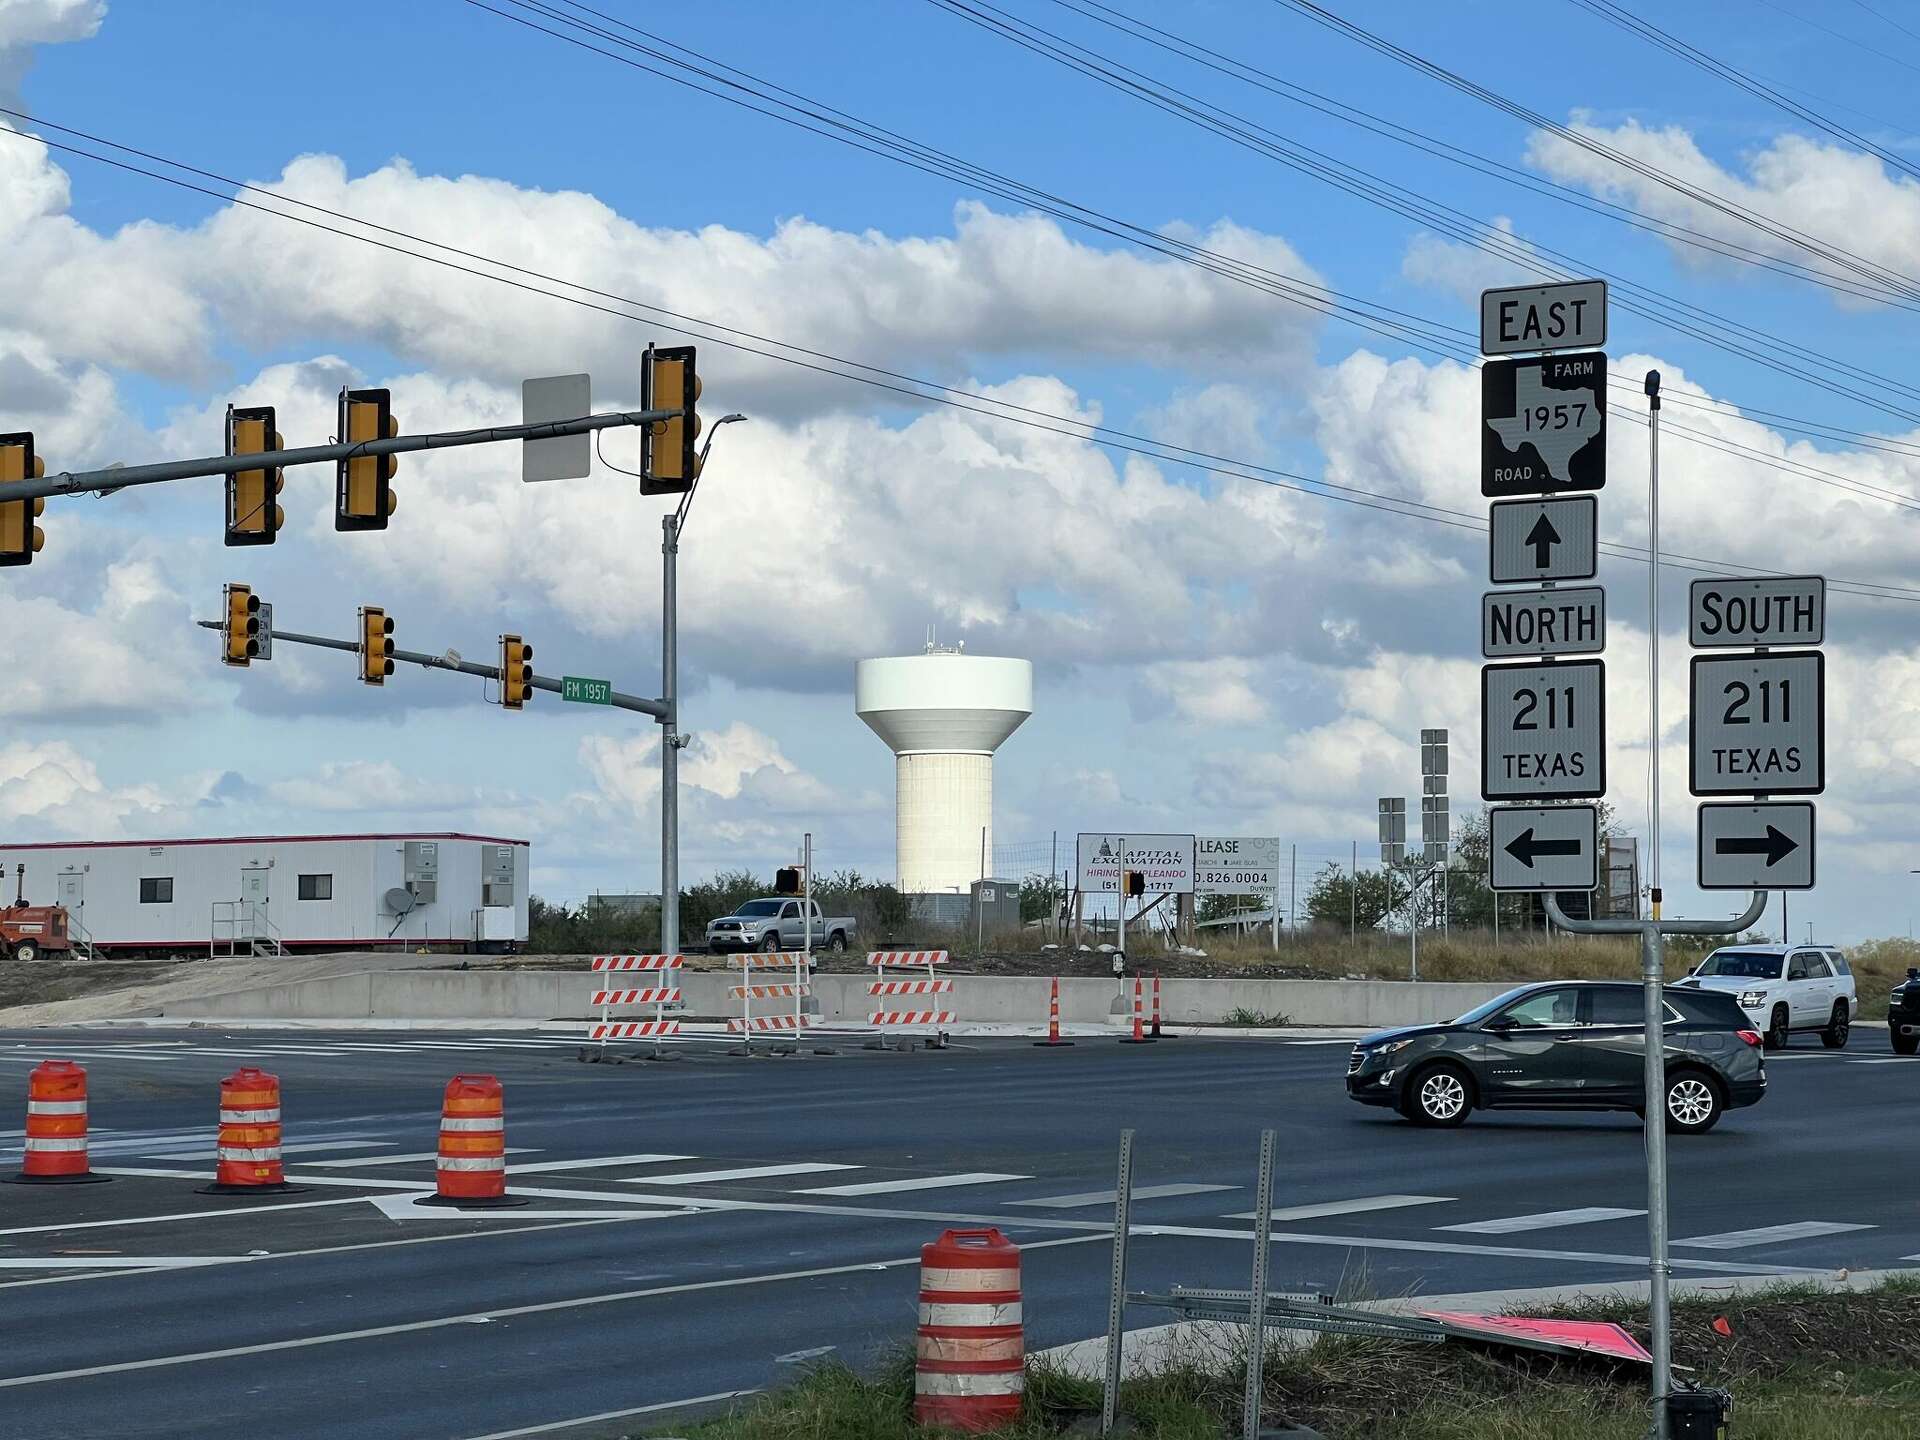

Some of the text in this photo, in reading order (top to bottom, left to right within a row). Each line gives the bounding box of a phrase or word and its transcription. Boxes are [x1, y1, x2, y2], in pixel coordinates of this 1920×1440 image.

[1499, 300, 1587, 342] EAST
[1554, 361, 1594, 377] FARM
[1523, 403, 1587, 432] 1957
[1494, 466, 1533, 482] ROAD
[1490, 604, 1596, 646] NORTH
[1699, 591, 1814, 636] SOUTH
[566, 681, 607, 700] FM 1957
[1722, 679, 1791, 725] 211
[1512, 686, 1574, 731] 211
[1502, 751, 1585, 779] TEXAS
[1711, 746, 1802, 774] TEXAS
[1200, 840, 1239, 854] LEASE
[1086, 869, 1120, 878] HIRING
[1195, 872, 1267, 883] 0.826.0004
